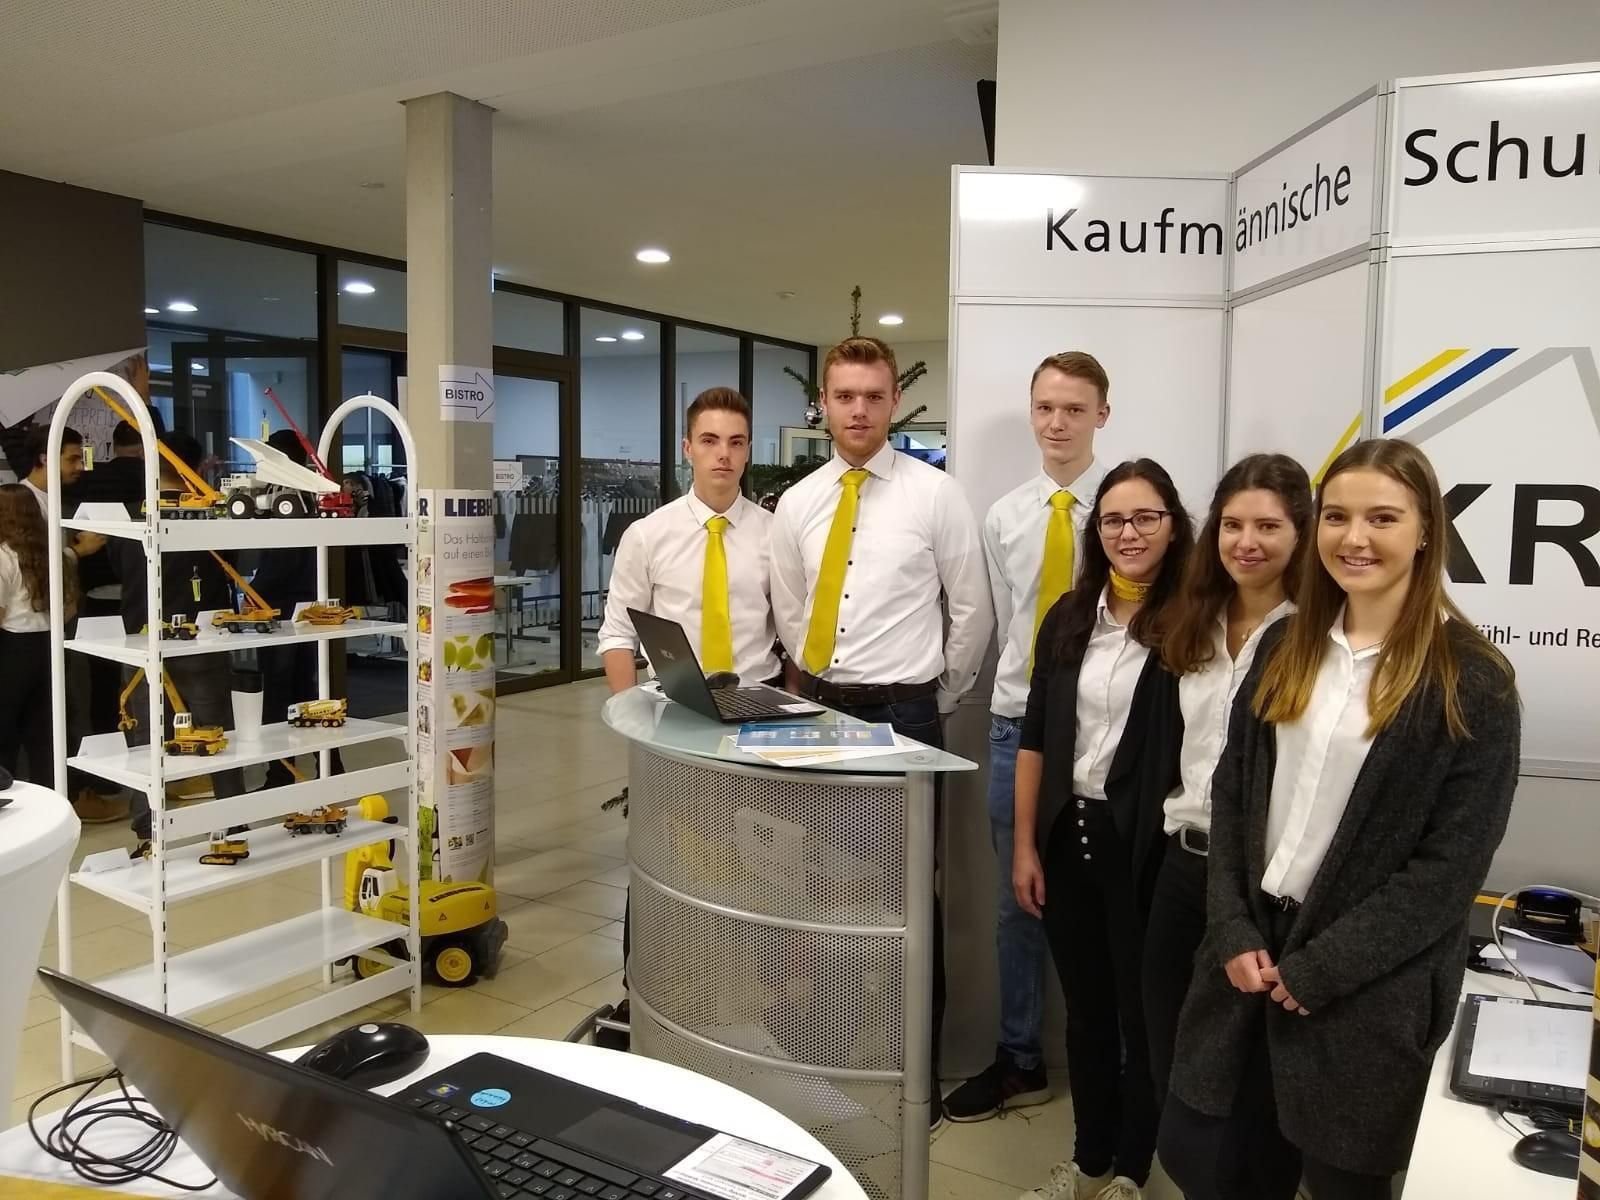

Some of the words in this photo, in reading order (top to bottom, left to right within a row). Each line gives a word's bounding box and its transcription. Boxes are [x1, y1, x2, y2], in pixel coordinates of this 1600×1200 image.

[1403, 120, 1600, 187] Schu
[445, 388, 485, 402] BISTRO
[495, 472, 515, 481] BISTRO
[443, 533, 464, 545] Das
[443, 548, 460, 560] auf
[1474, 623, 1521, 645] ühl-
[1528, 627, 1569, 648] und
